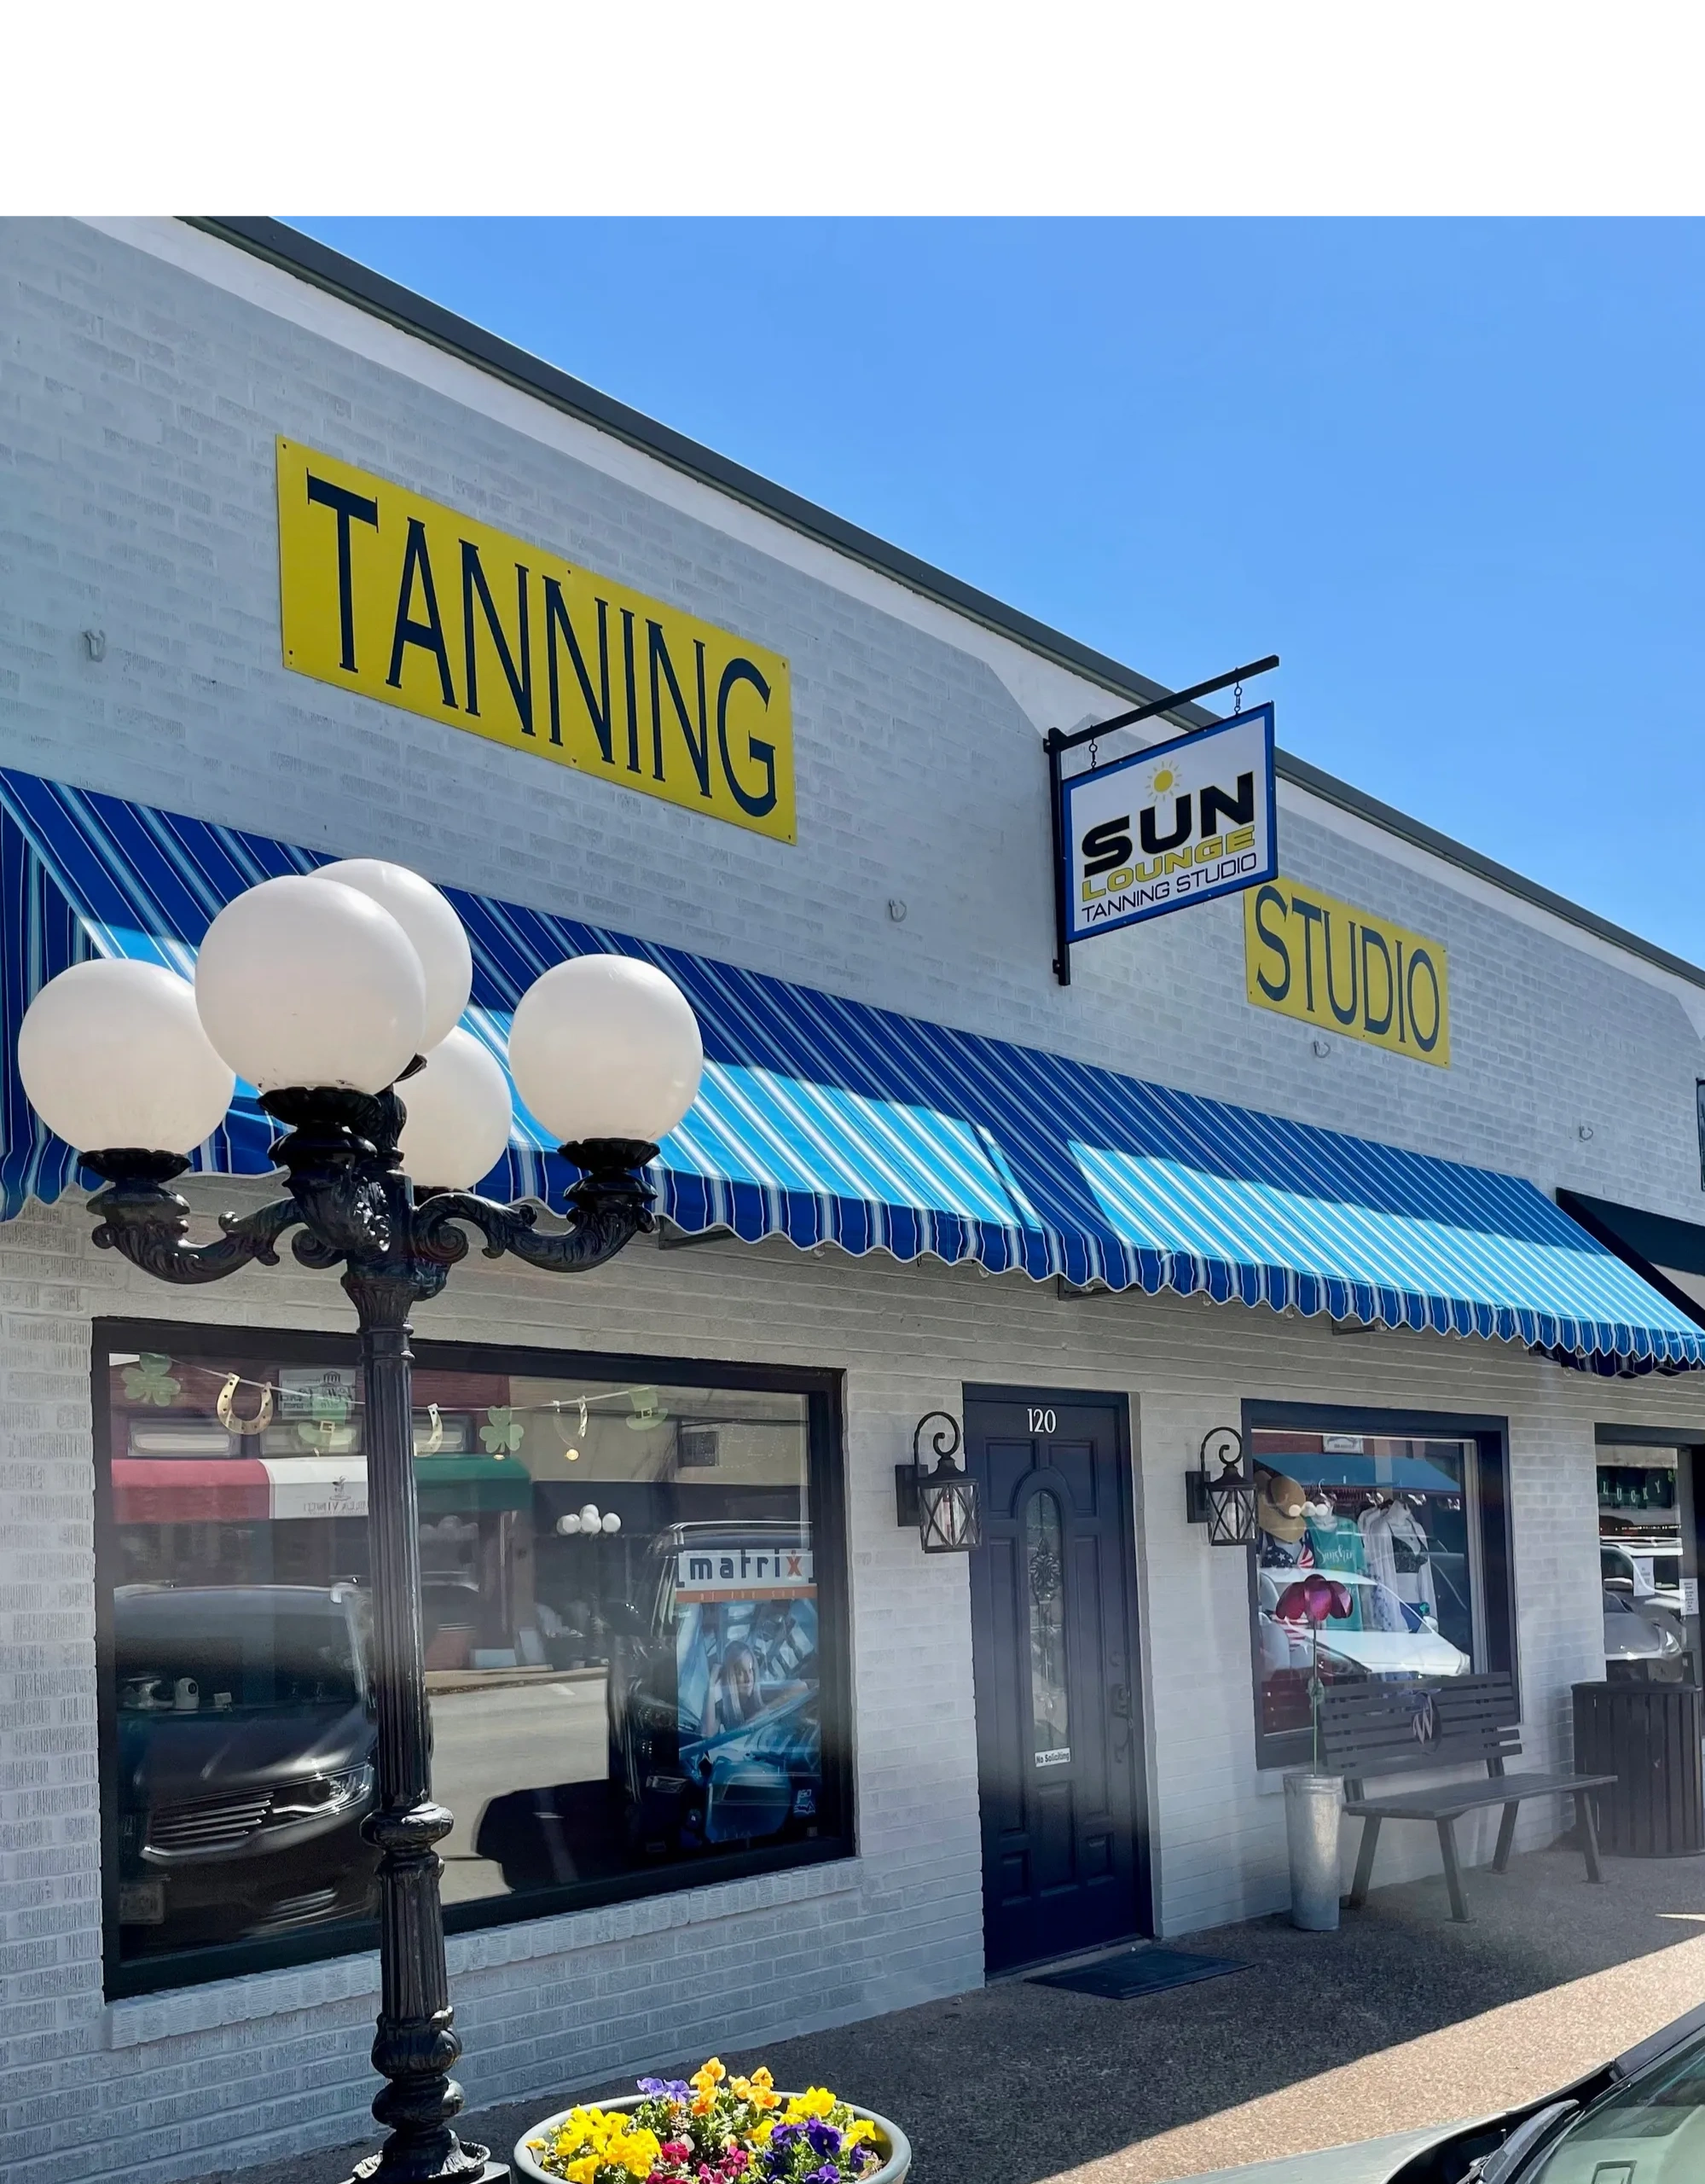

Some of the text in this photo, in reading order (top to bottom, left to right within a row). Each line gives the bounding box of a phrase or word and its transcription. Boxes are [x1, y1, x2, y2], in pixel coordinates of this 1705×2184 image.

[306, 467, 777, 817] TANNING
[1082, 771, 1254, 878] SUN
[1082, 825, 1255, 902] LOUNGE
[1082, 853, 1256, 922] TANNING STUDIO
[1256, 885, 1440, 1052] STUDIO
[1027, 1409, 1057, 1433] 120
[1603, 1478, 1661, 1503] LUCKY
[689, 1549, 802, 1580] matrix
[1045, 1751, 1069, 1763] Soliciting
